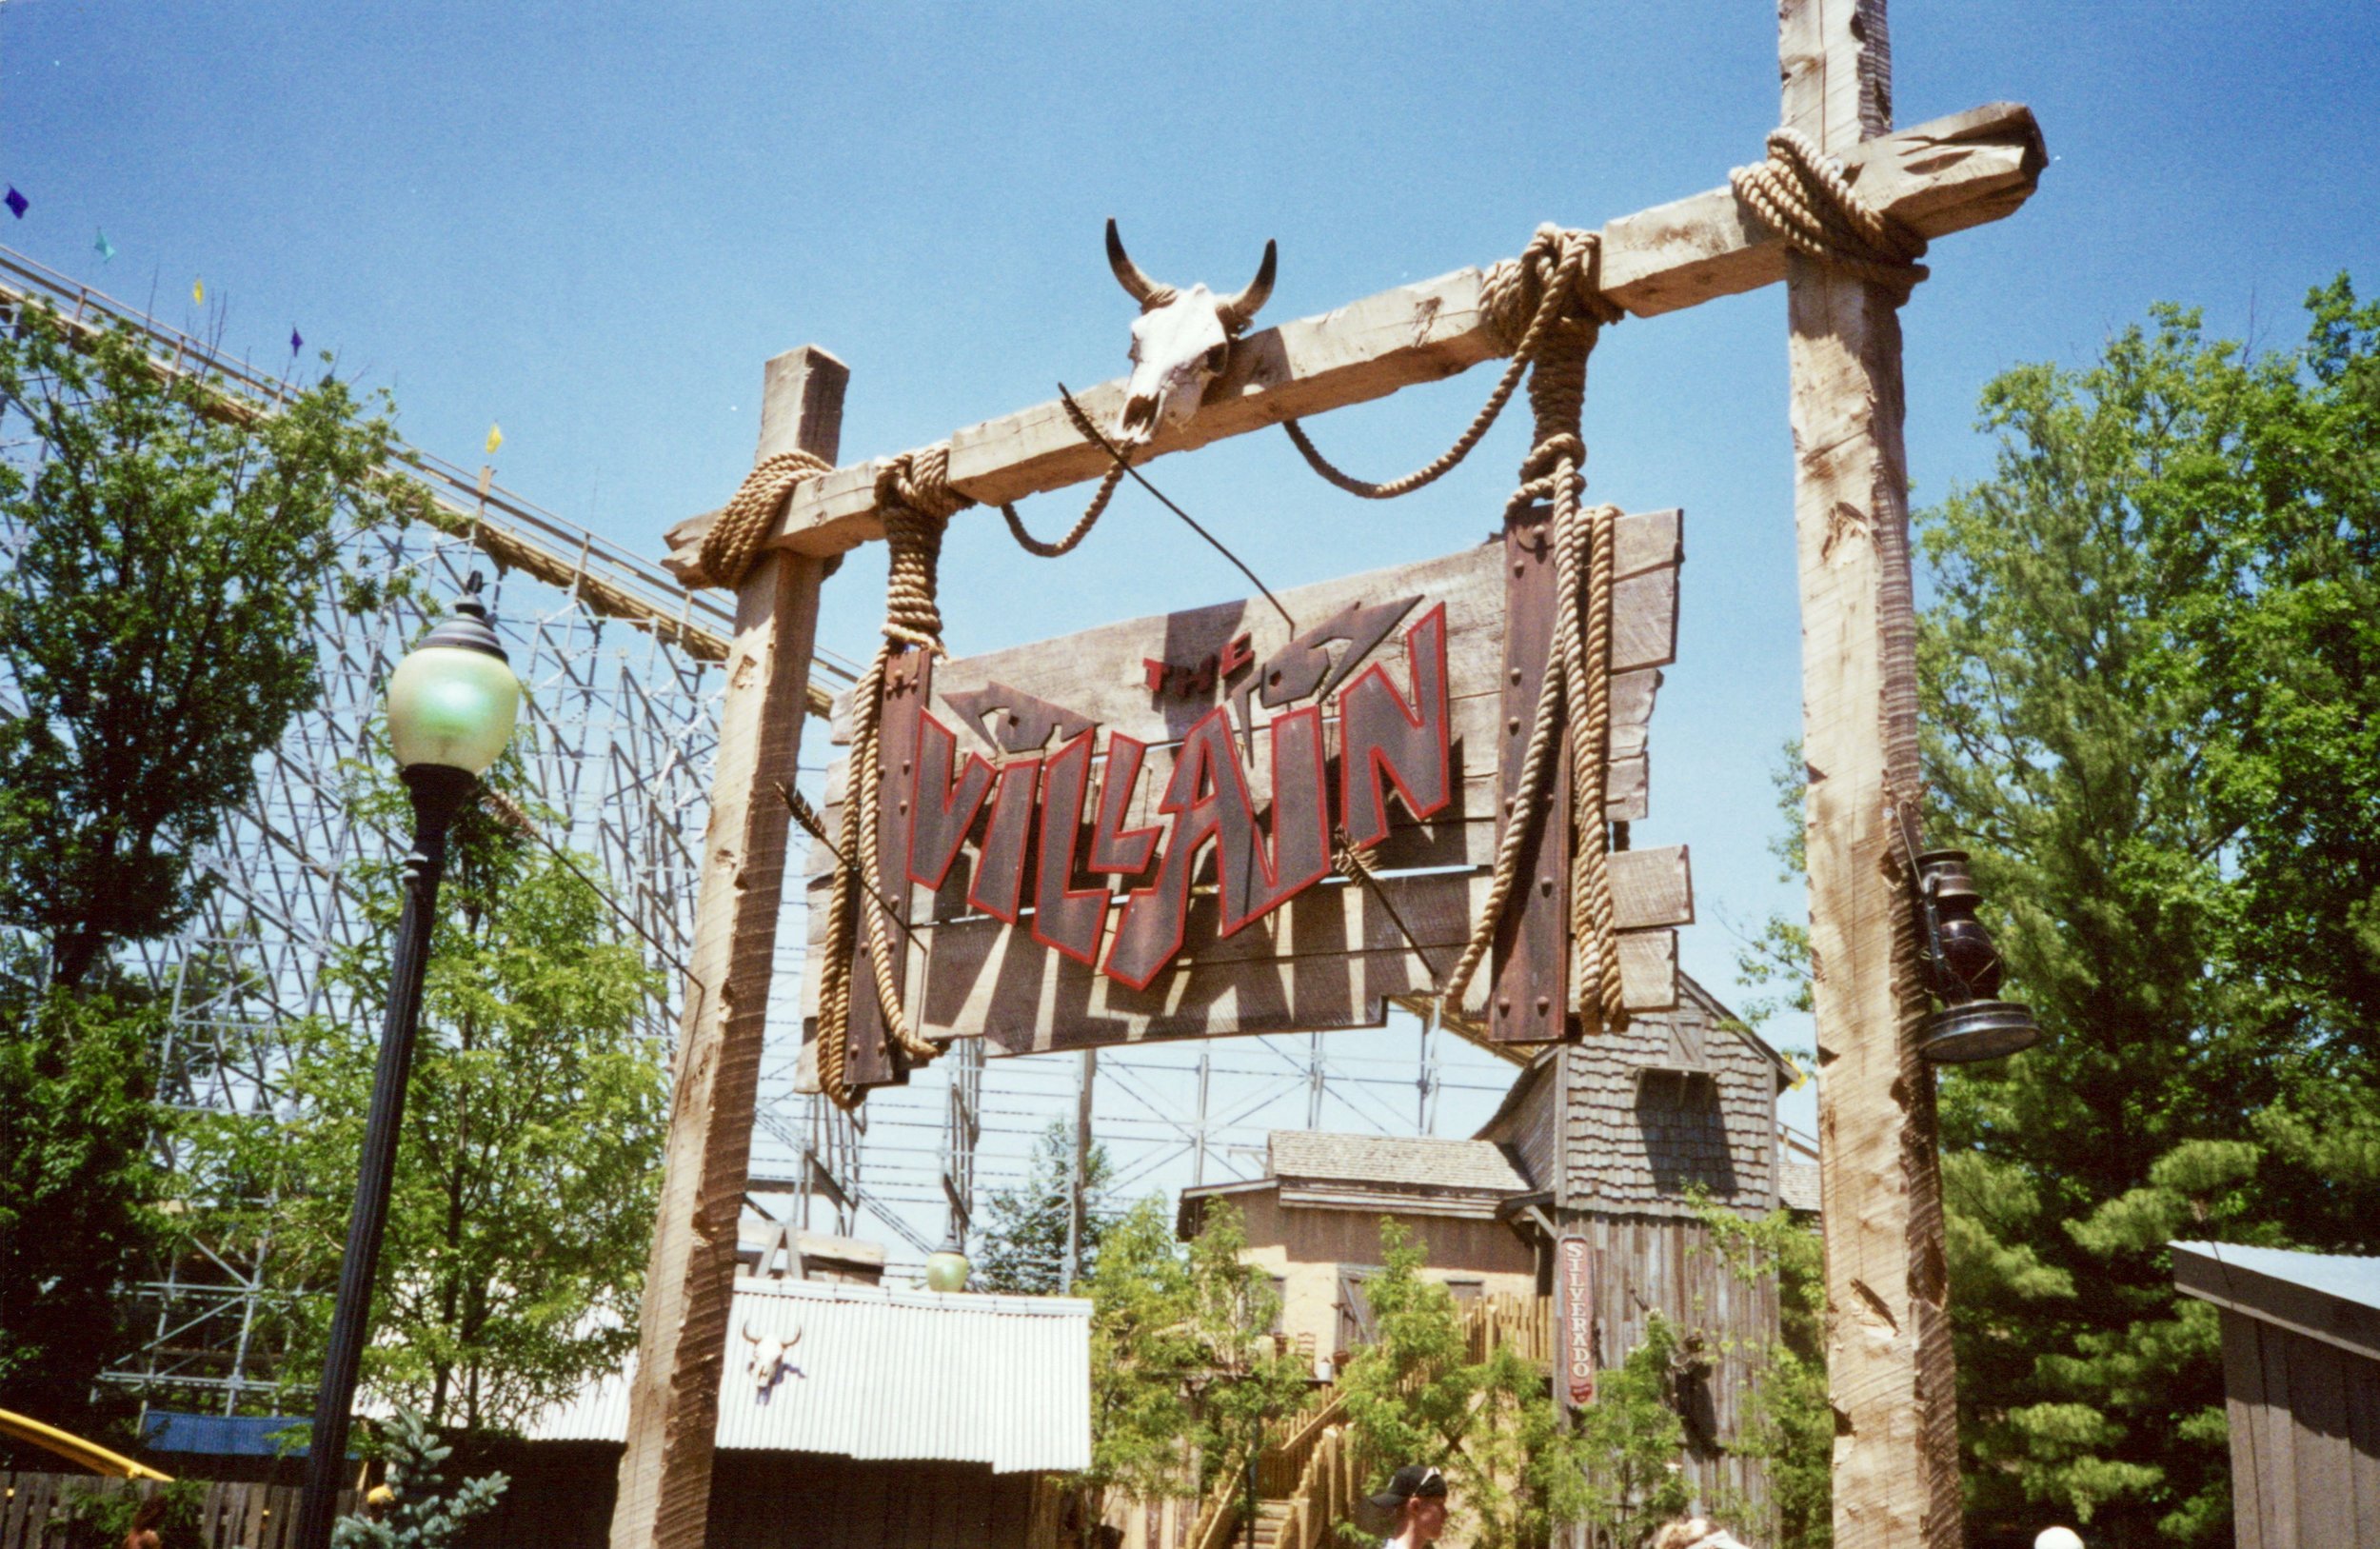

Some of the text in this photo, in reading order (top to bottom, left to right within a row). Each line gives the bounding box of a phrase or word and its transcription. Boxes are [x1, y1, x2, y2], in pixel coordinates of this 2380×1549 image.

[1142, 631, 1256, 698] THE
[908, 602, 1450, 990] VILLAIN
[1566, 1243, 1590, 1378] SILVERADO
